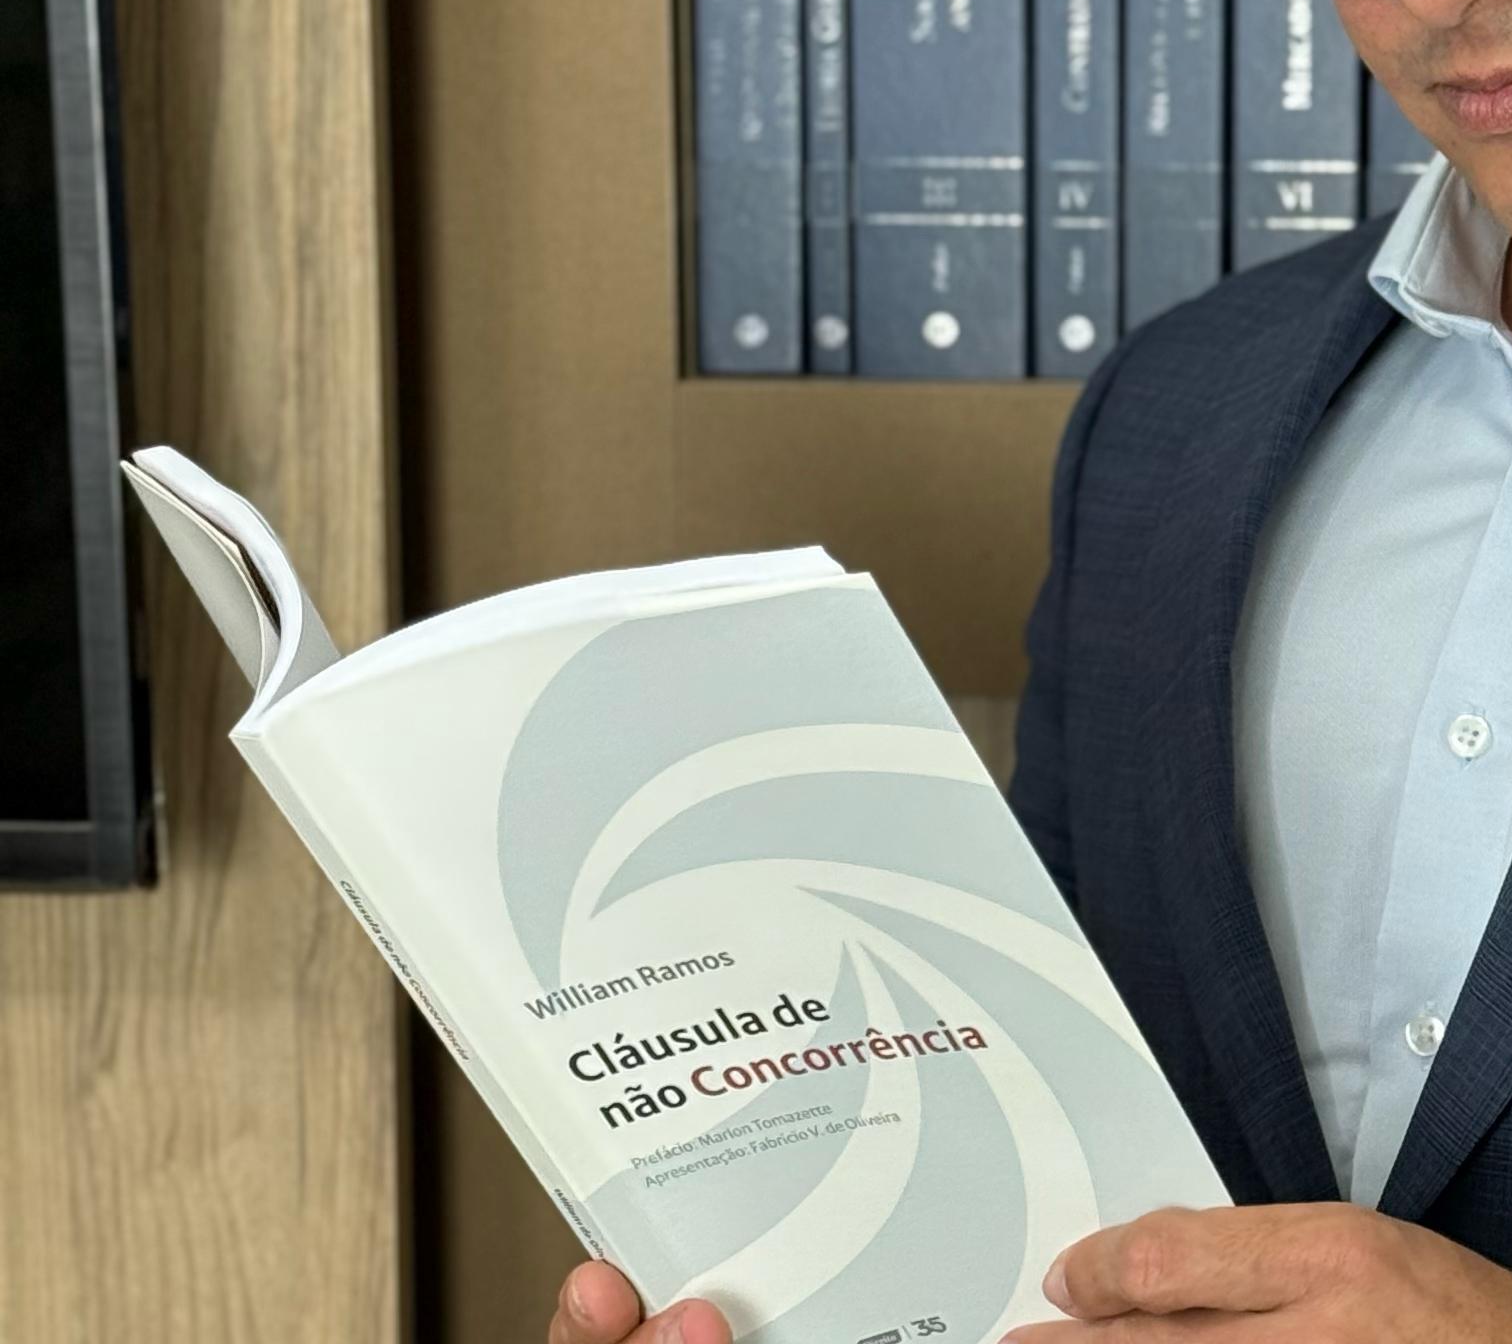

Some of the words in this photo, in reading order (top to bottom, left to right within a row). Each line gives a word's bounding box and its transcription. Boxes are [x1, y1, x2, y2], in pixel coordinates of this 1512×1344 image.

[340, 879, 382, 935] Cláusula
[523, 975, 638, 1020] William
[635, 951, 736, 987] Ramos
[568, 1008, 769, 1082] Cláusula
[772, 993, 831, 1028] de
[599, 1084, 687, 1129] não
[690, 1019, 989, 1097] Concorrência
[644, 1142, 750, 1188] Apresentação:
[844, 1109, 902, 1132] Oliveira
[751, 1104, 834, 1133] Tomazette
